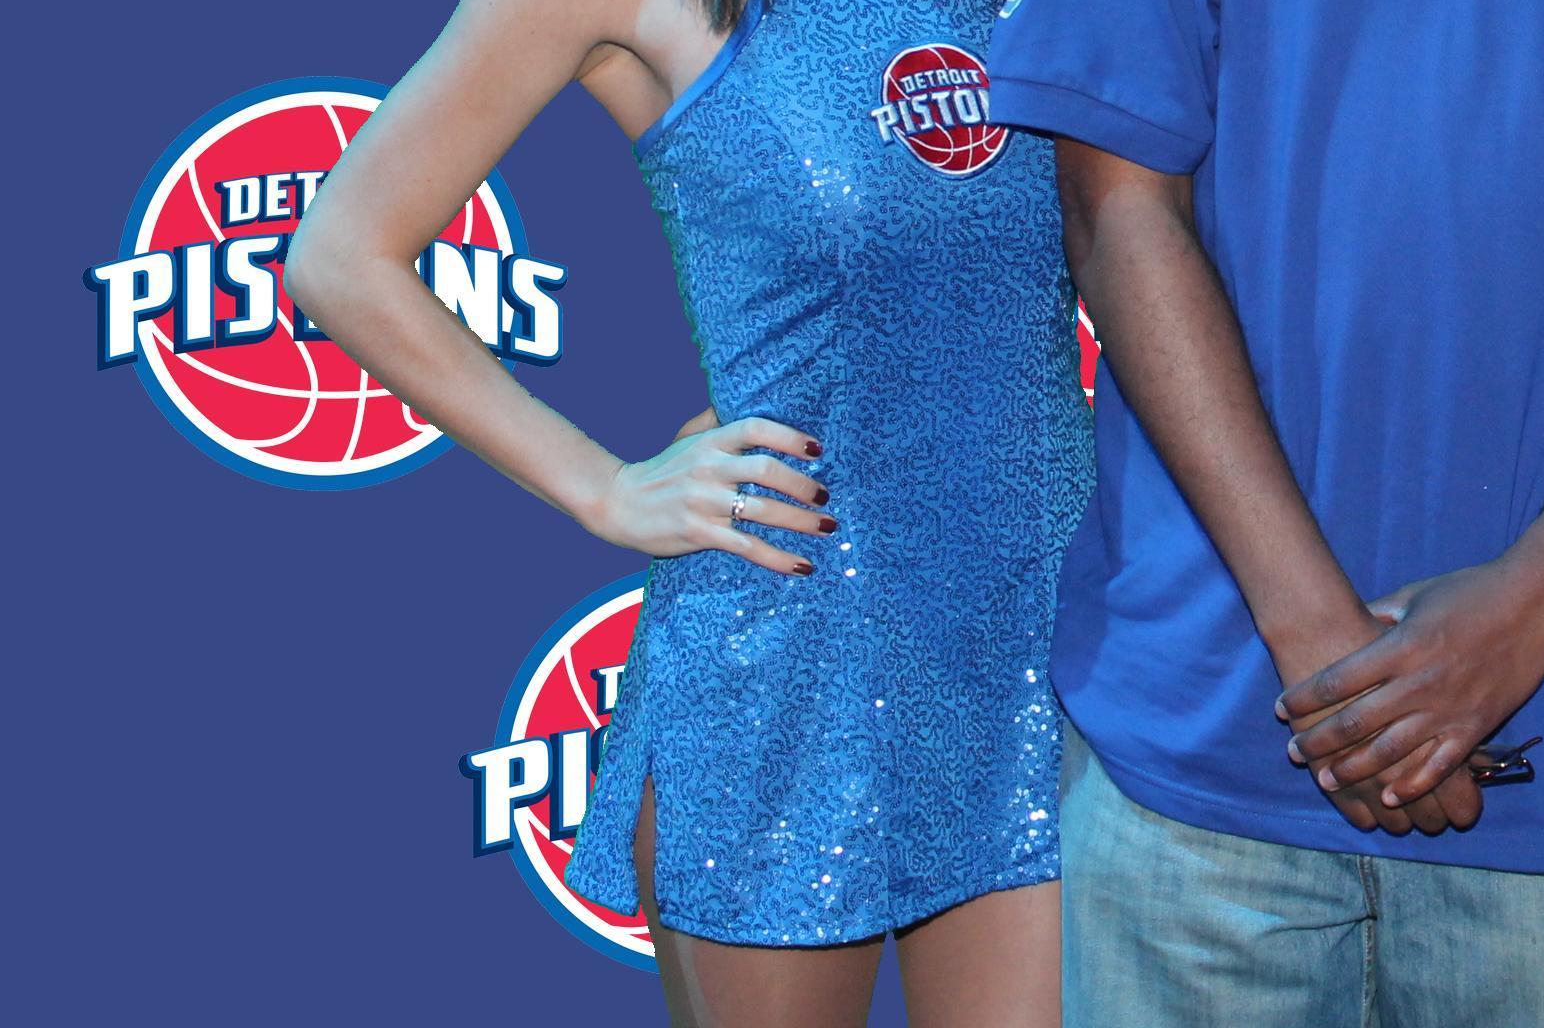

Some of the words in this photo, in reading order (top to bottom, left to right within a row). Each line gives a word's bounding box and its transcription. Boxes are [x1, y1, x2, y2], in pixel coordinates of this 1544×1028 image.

[899, 69, 982, 94] DETROIT
[871, 88, 990, 146] PISTO
[82, 233, 568, 371] PISNS
